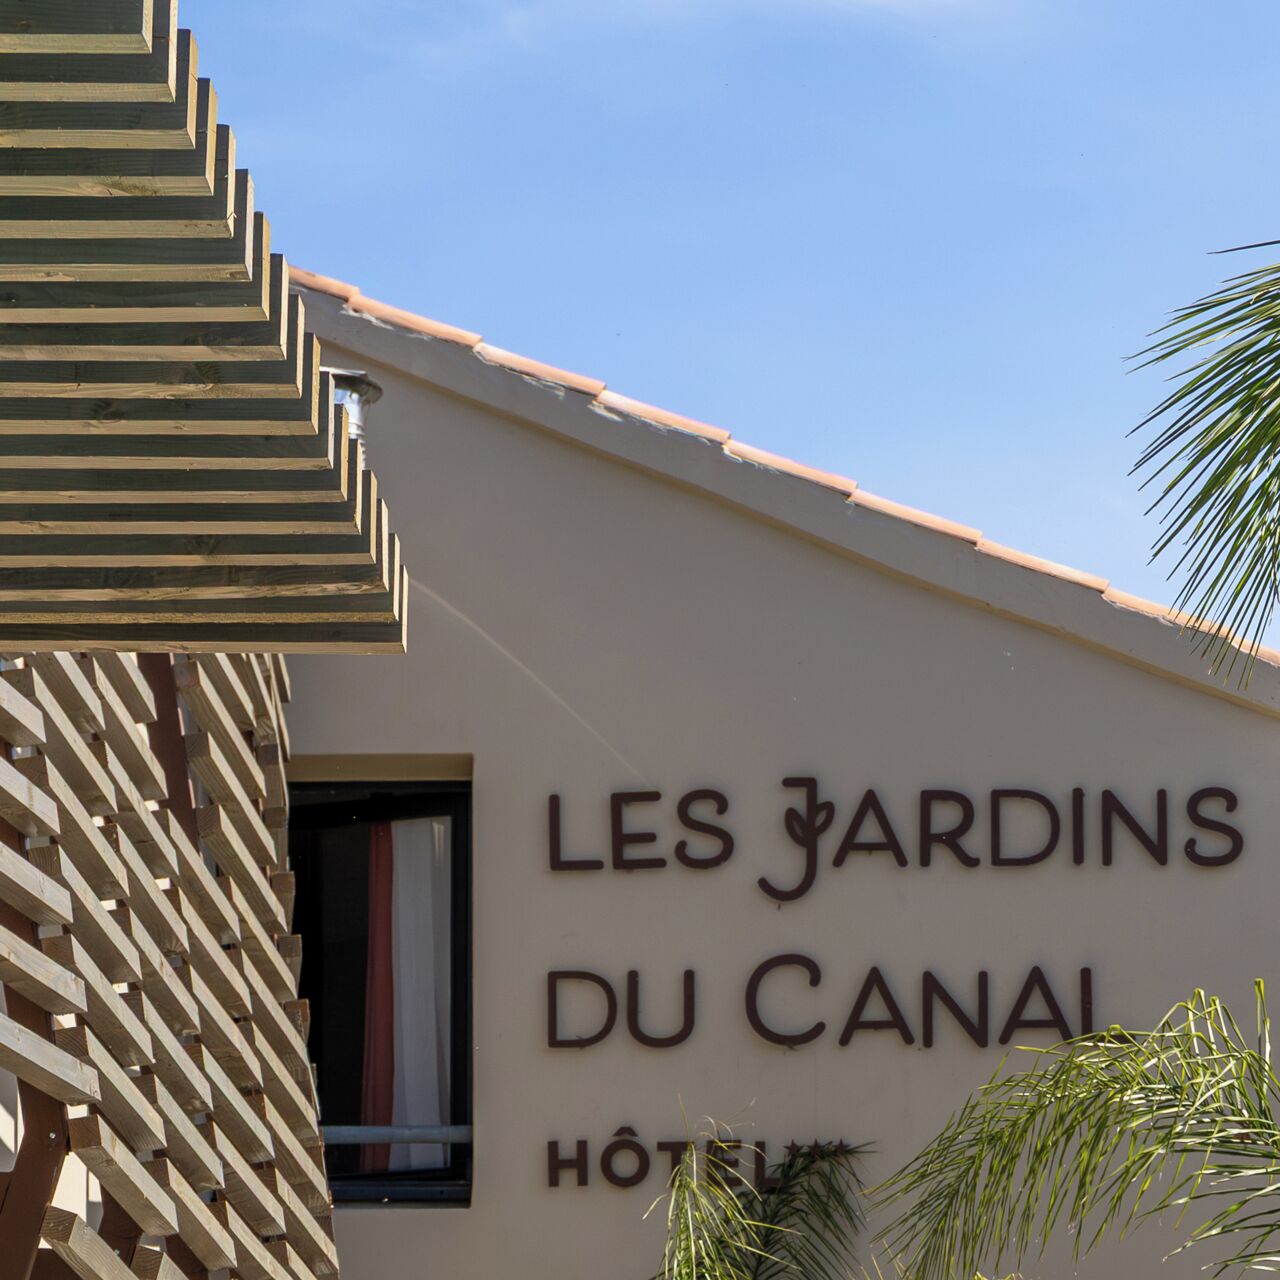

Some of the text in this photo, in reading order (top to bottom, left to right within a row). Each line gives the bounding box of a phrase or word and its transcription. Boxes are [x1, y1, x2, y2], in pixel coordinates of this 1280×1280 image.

[548, 776, 1245, 901] LES JARDINS
[547, 968, 696, 1049] DU
[547, 1126, 788, 1188] HÔTEL
